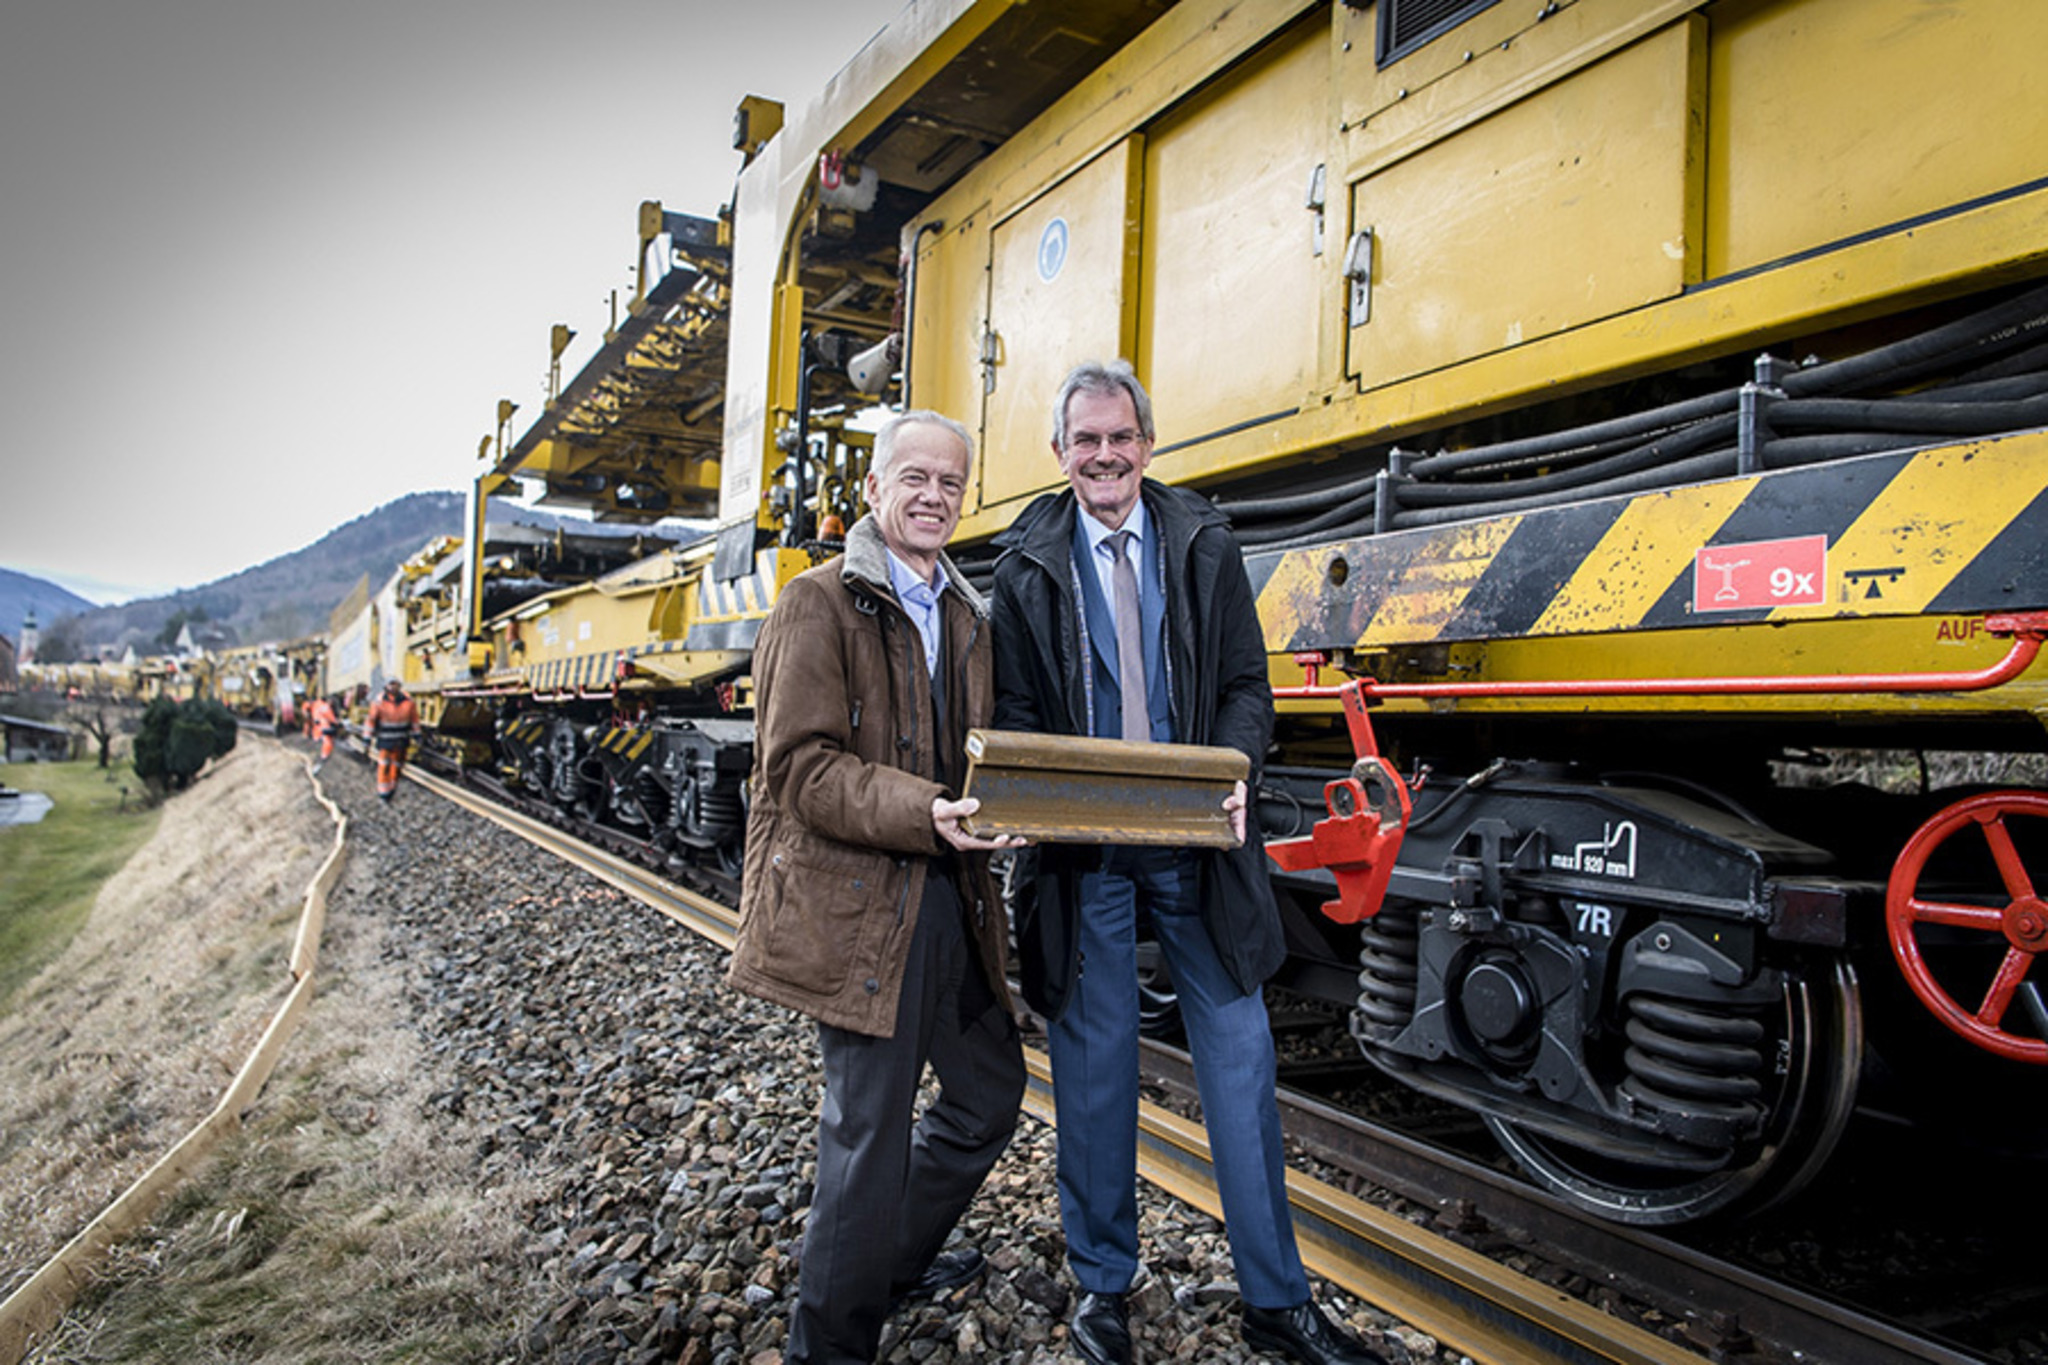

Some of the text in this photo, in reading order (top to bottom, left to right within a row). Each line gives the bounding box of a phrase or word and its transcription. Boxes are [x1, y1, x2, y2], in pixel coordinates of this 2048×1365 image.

[1769, 567, 1815, 598] 9x
[1936, 618, 1983, 640] AUF
[1606, 862, 1628, 877] mm
[1576, 903, 1612, 937] 7R
